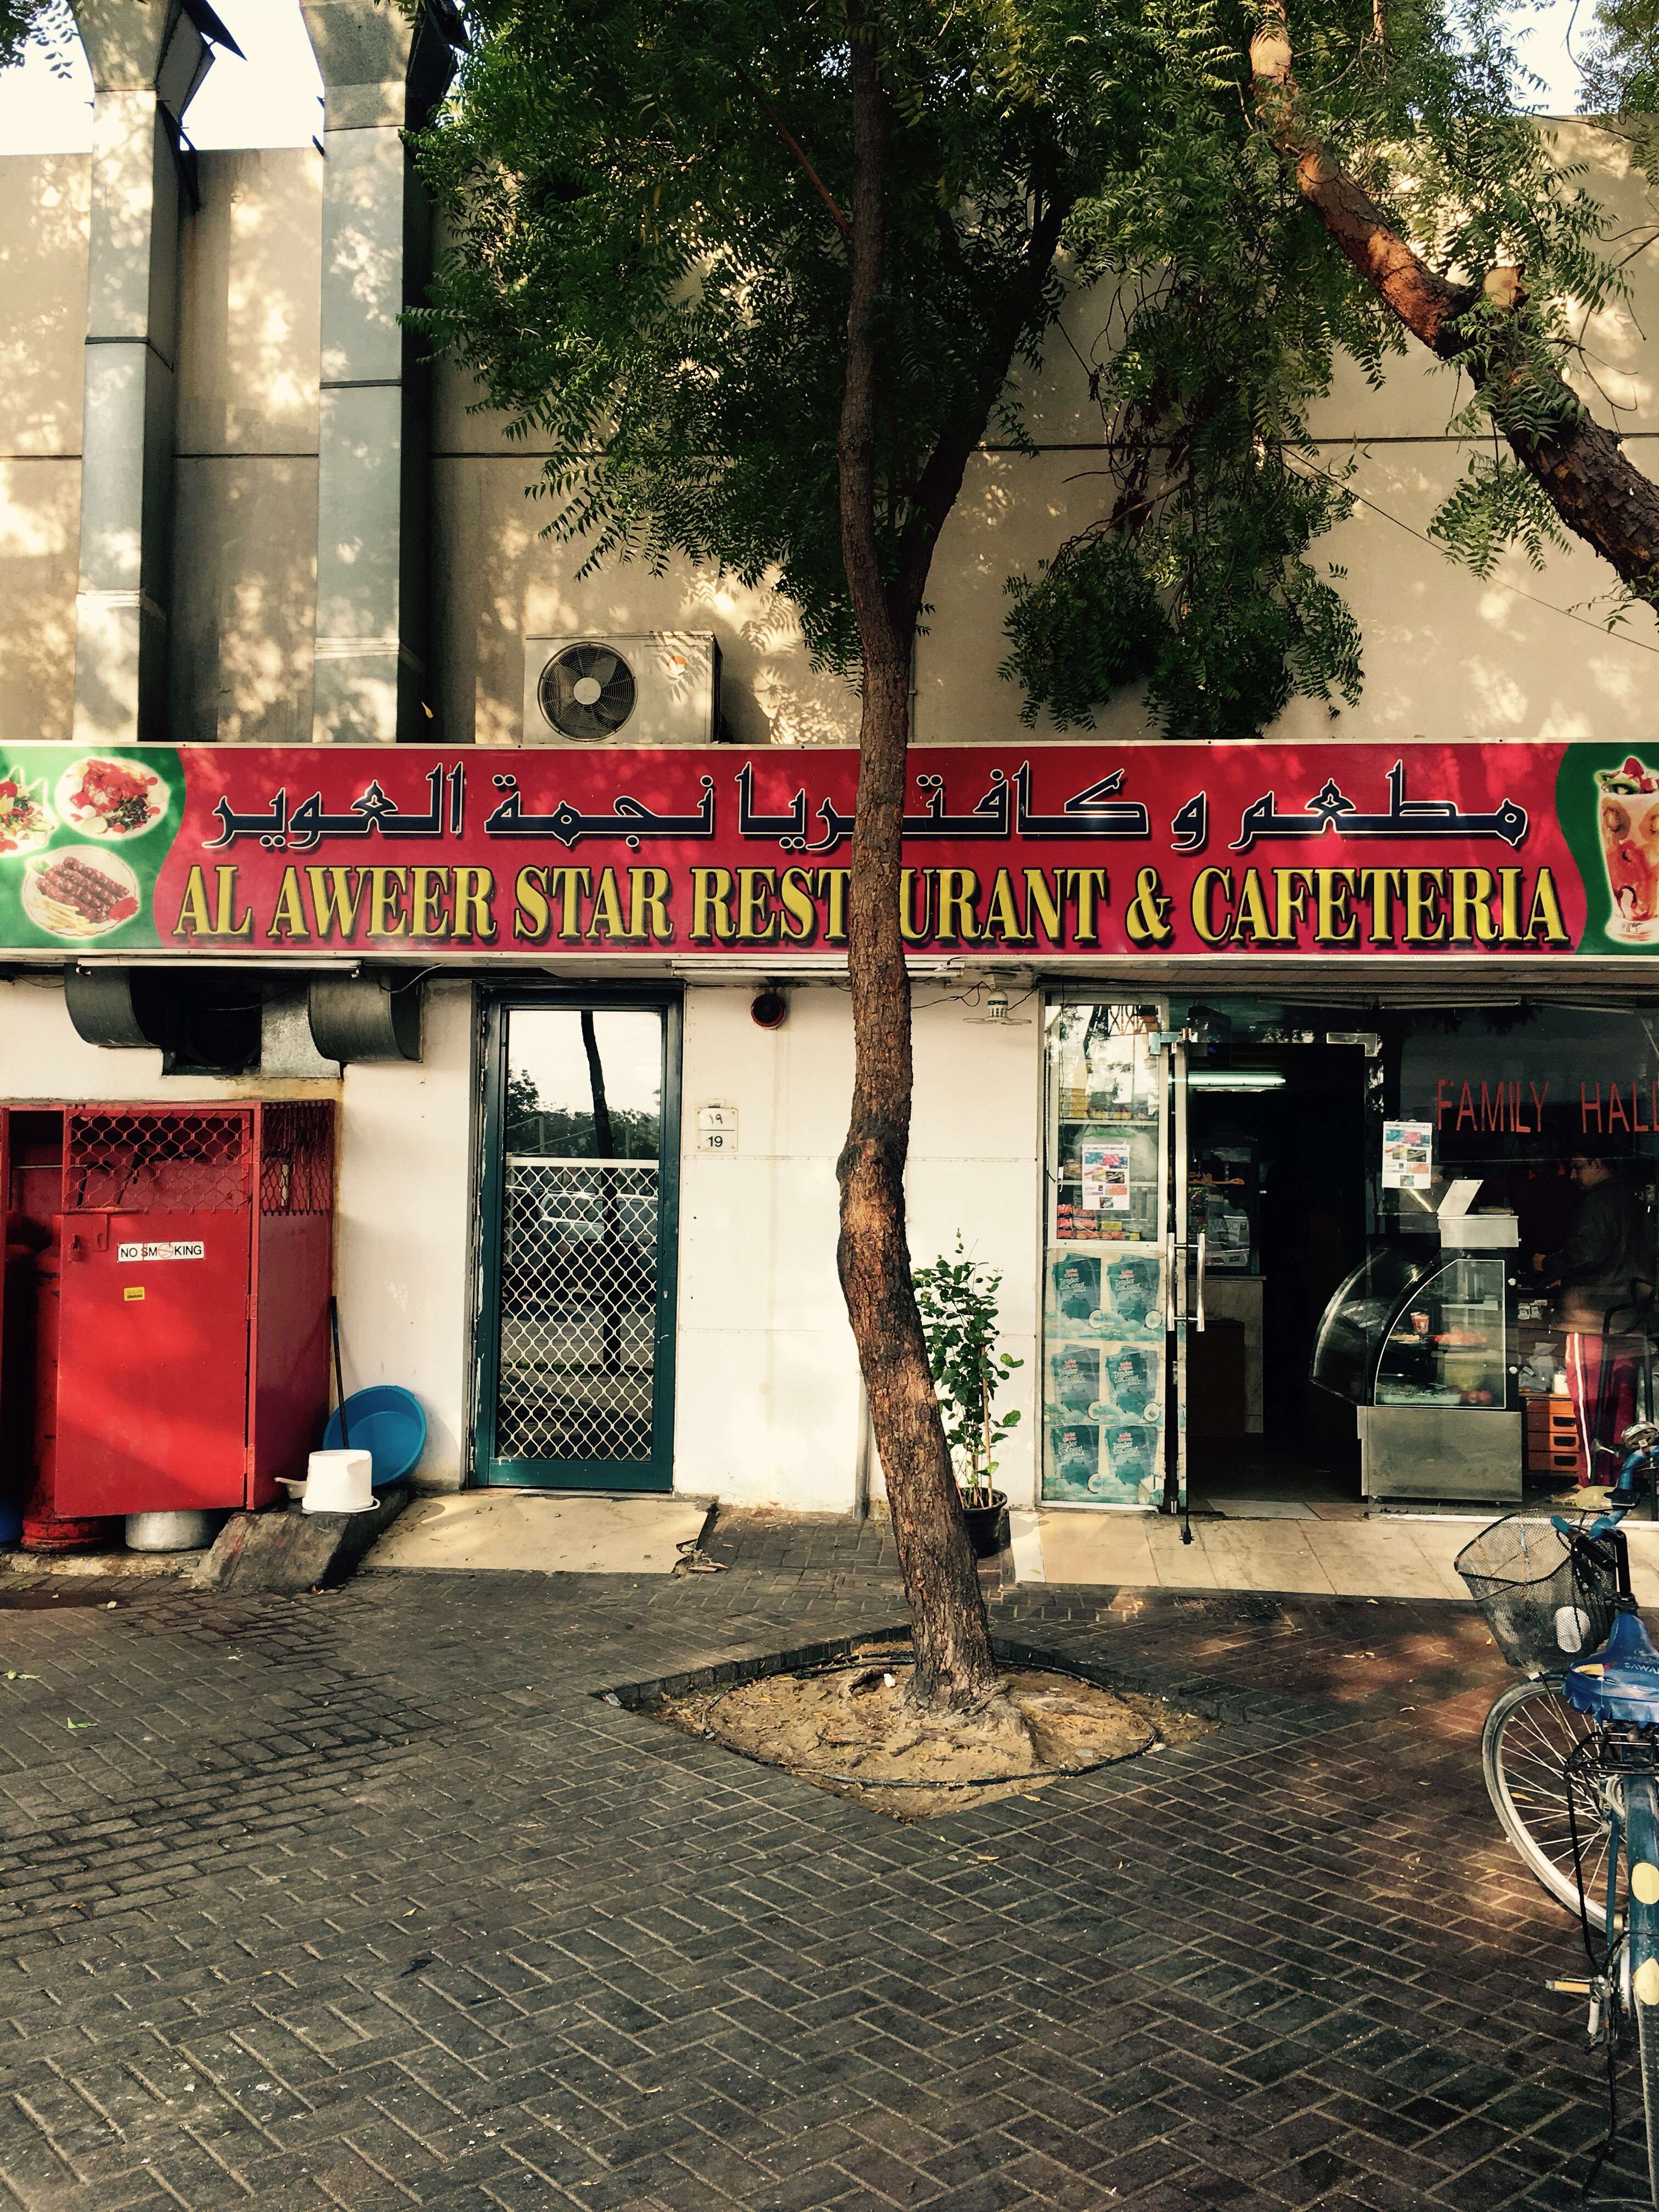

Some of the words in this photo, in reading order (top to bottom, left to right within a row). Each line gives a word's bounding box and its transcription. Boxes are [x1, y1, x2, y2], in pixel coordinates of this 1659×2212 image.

[201, 760, 465, 849] العوير
[484, 773, 714, 850] نجمة
[1228, 759, 1528, 850] مطعم
[173, 865, 252, 938] AL
[267, 865, 498, 939] AWEER
[514, 865, 673, 941] STAR
[689, 865, 1109, 944] RESTURANT
[1125, 867, 1172, 943] &
[1190, 866, 1569, 945] CAFETERIA
[709, 1114, 723, 1125] ١٩
[1437, 1080, 1549, 1133] FAMILY
[1580, 1080, 1659, 1133] HALL
[708, 1136, 723, 1147] 19
[121, 1247, 138, 1257] NO
[1113, 1370, 1134, 1378] Tender
[1624, 1662, 1659, 1675] SAWA
